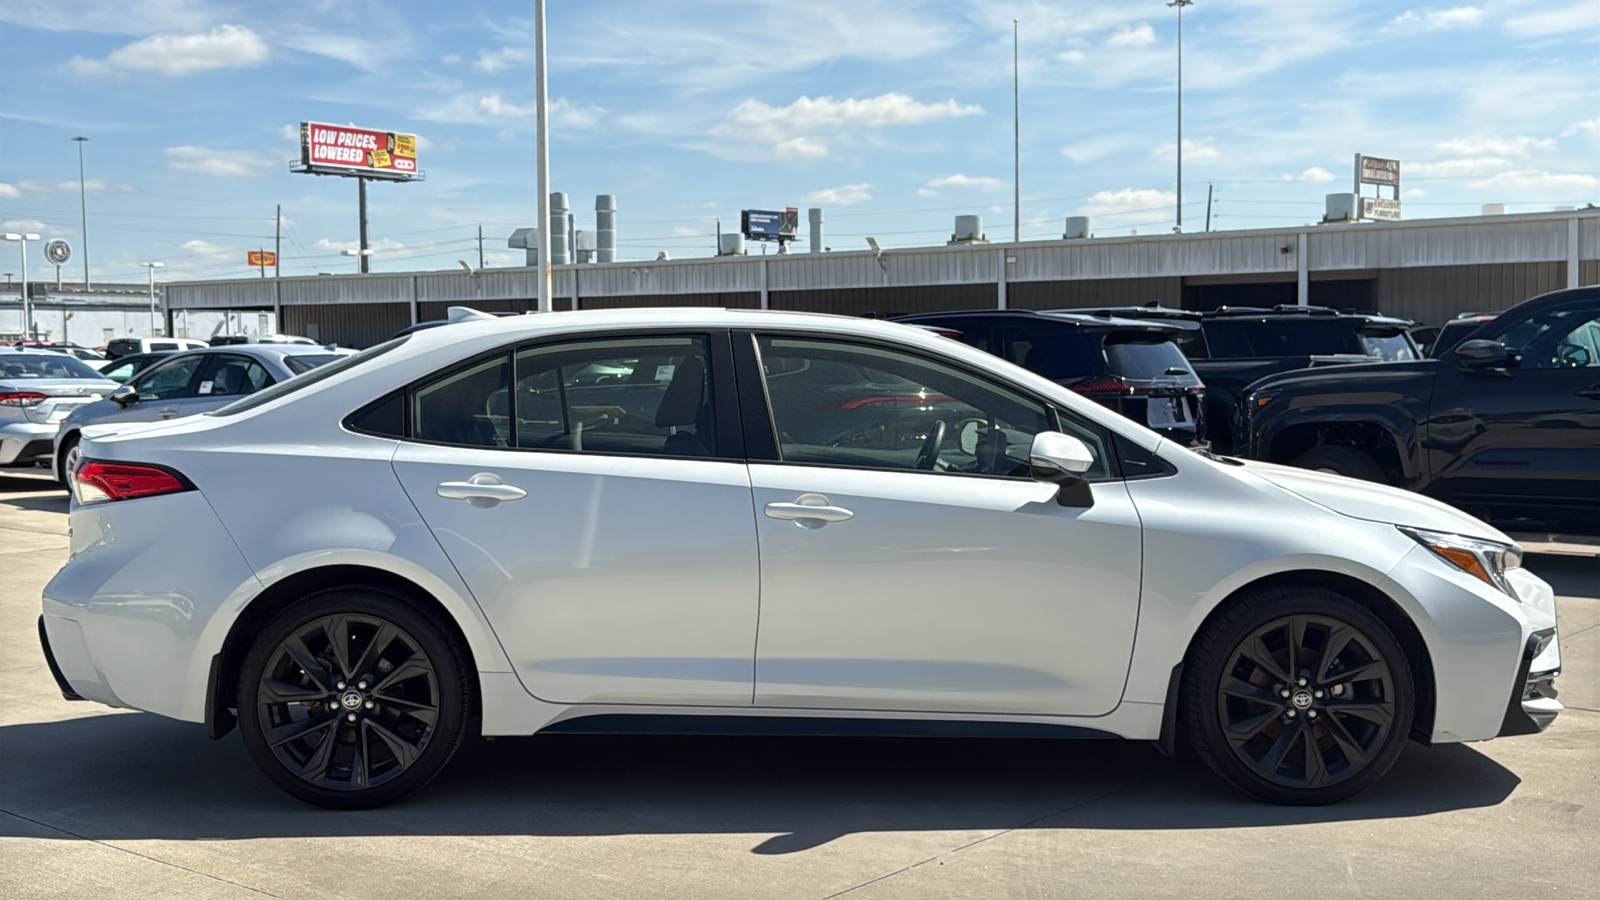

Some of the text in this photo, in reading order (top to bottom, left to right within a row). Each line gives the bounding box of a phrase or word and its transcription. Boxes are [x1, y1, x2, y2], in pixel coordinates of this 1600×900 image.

[313, 128, 337, 144] LOW
[337, 131, 378, 151] PRICES,
[313, 144, 364, 163] LOWERED
[1374, 200, 1400, 210] EXCLUSIVE
[1374, 209, 1400, 219] FURNITURE
